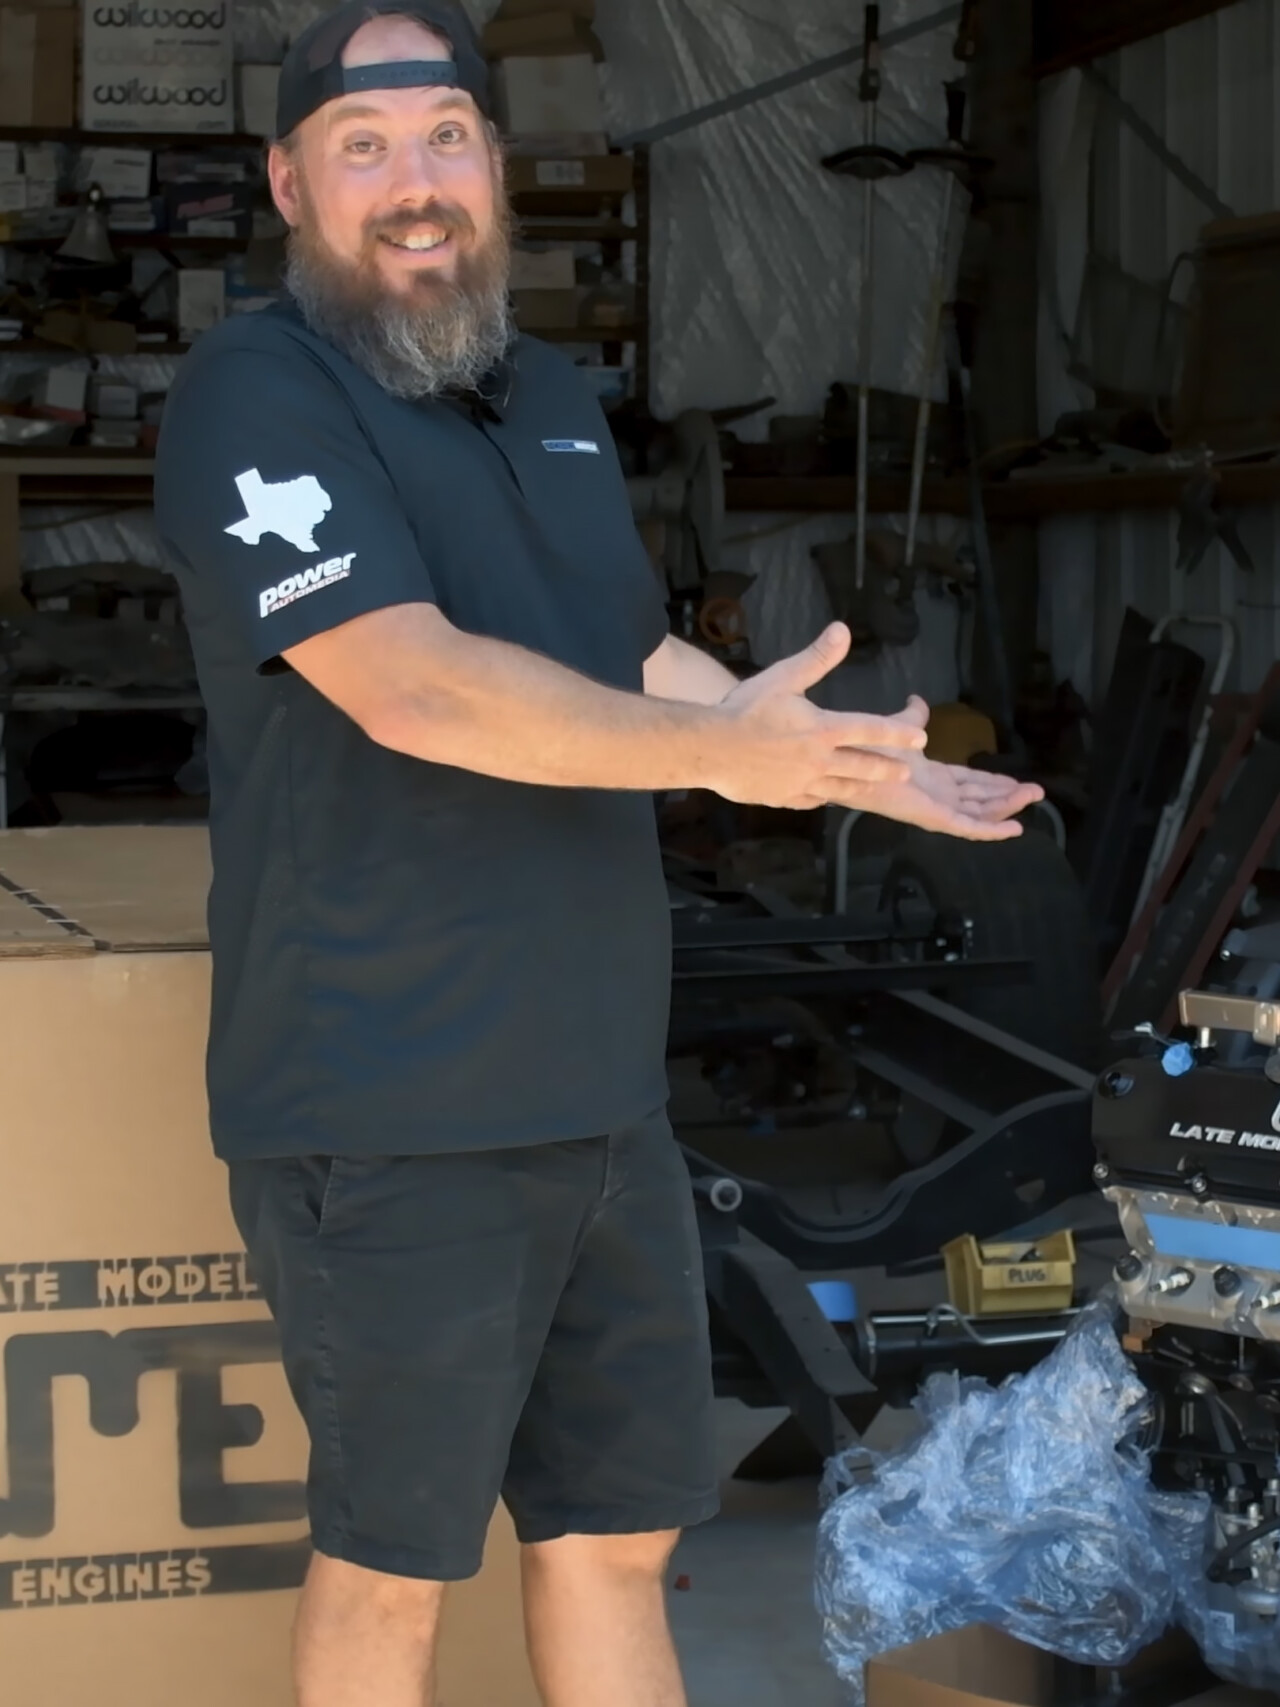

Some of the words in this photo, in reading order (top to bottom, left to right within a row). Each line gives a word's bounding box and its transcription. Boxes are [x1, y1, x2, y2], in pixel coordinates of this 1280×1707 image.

[93, 1, 227, 30] wilwood
[93, 78, 227, 106] wilwood
[259, 552, 357, 618] power
[269, 570, 350, 613] AUTOMEDIA
[1169, 1122, 1235, 1144] LATE
[97, 1261, 259, 1303] MODEL
[1008, 1268, 1046, 1283] PLUG
[12, 1556, 212, 1602] ENGINES
